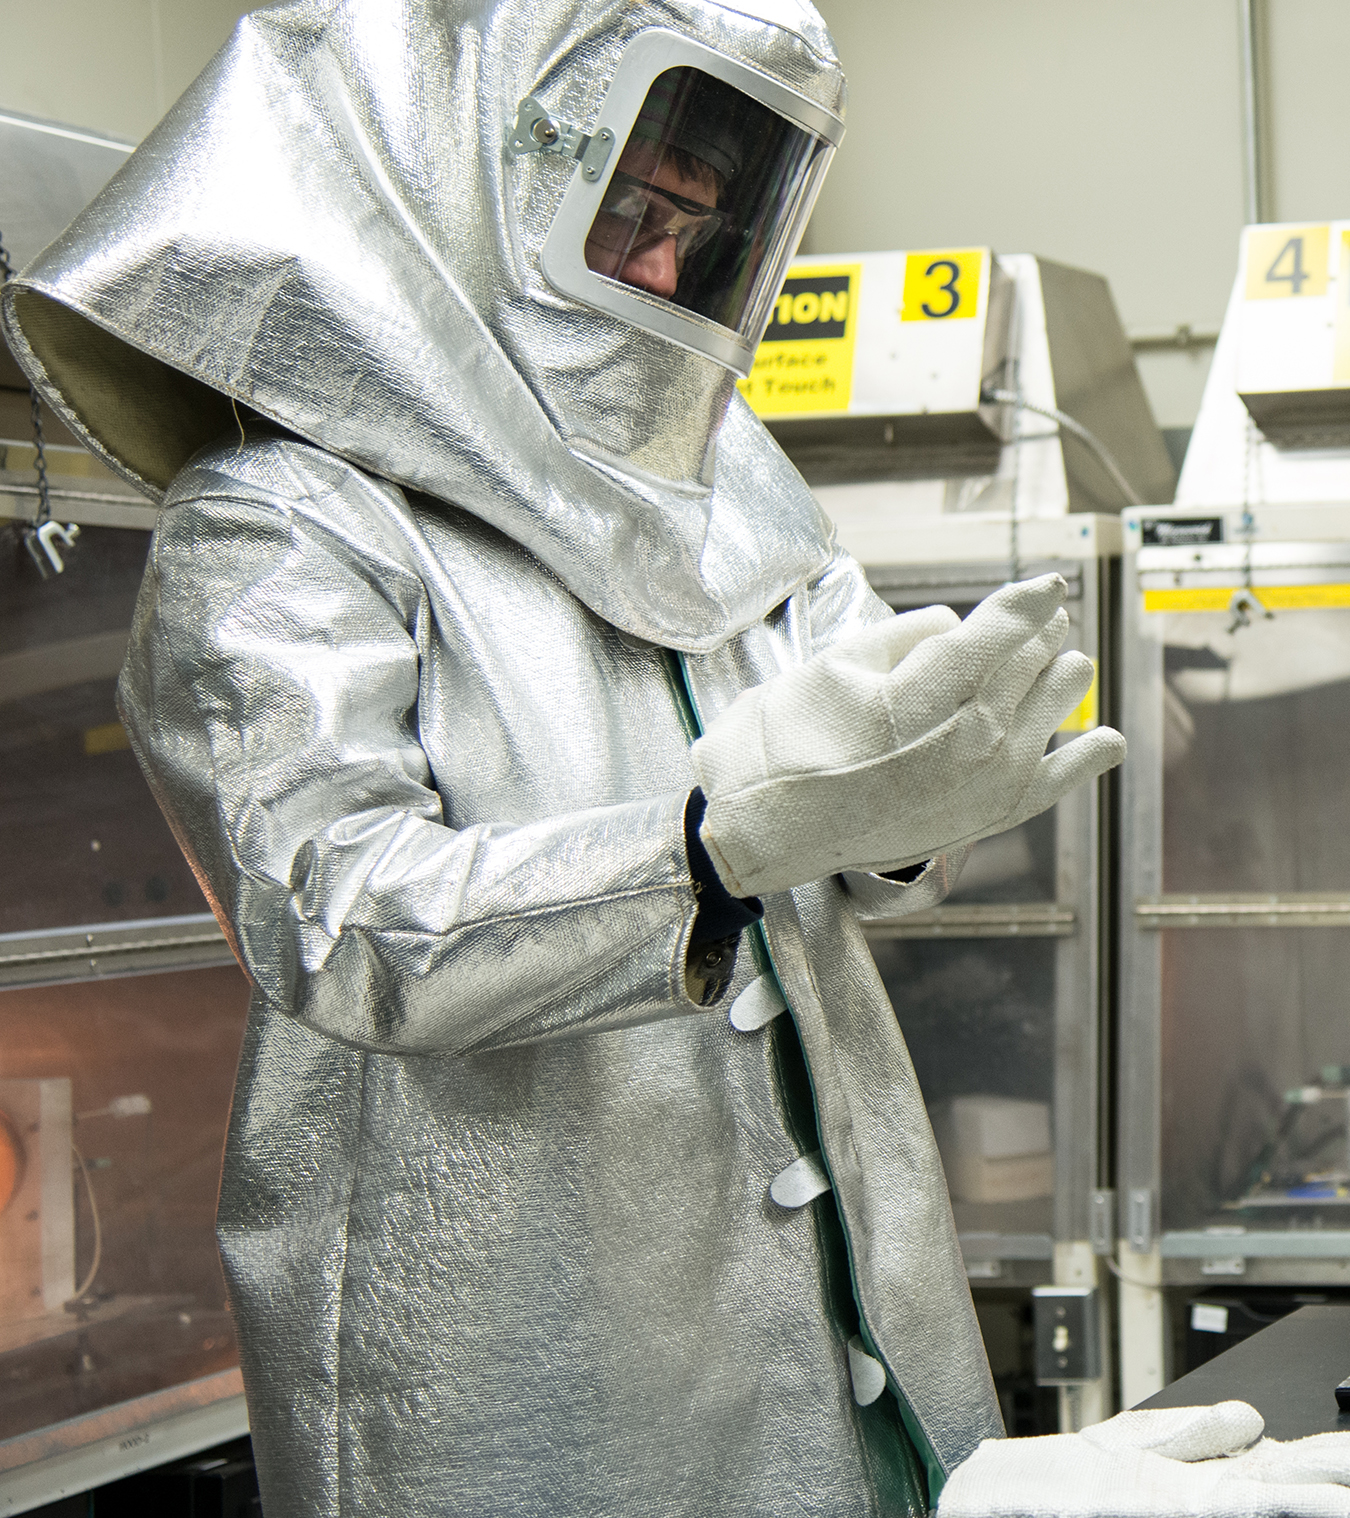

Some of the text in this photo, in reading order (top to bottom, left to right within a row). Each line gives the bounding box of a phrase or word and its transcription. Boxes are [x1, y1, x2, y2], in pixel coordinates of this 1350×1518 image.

[921, 260, 961, 318] 3
[1265, 236, 1309, 294] 4
[753, 354, 828, 369] urface
